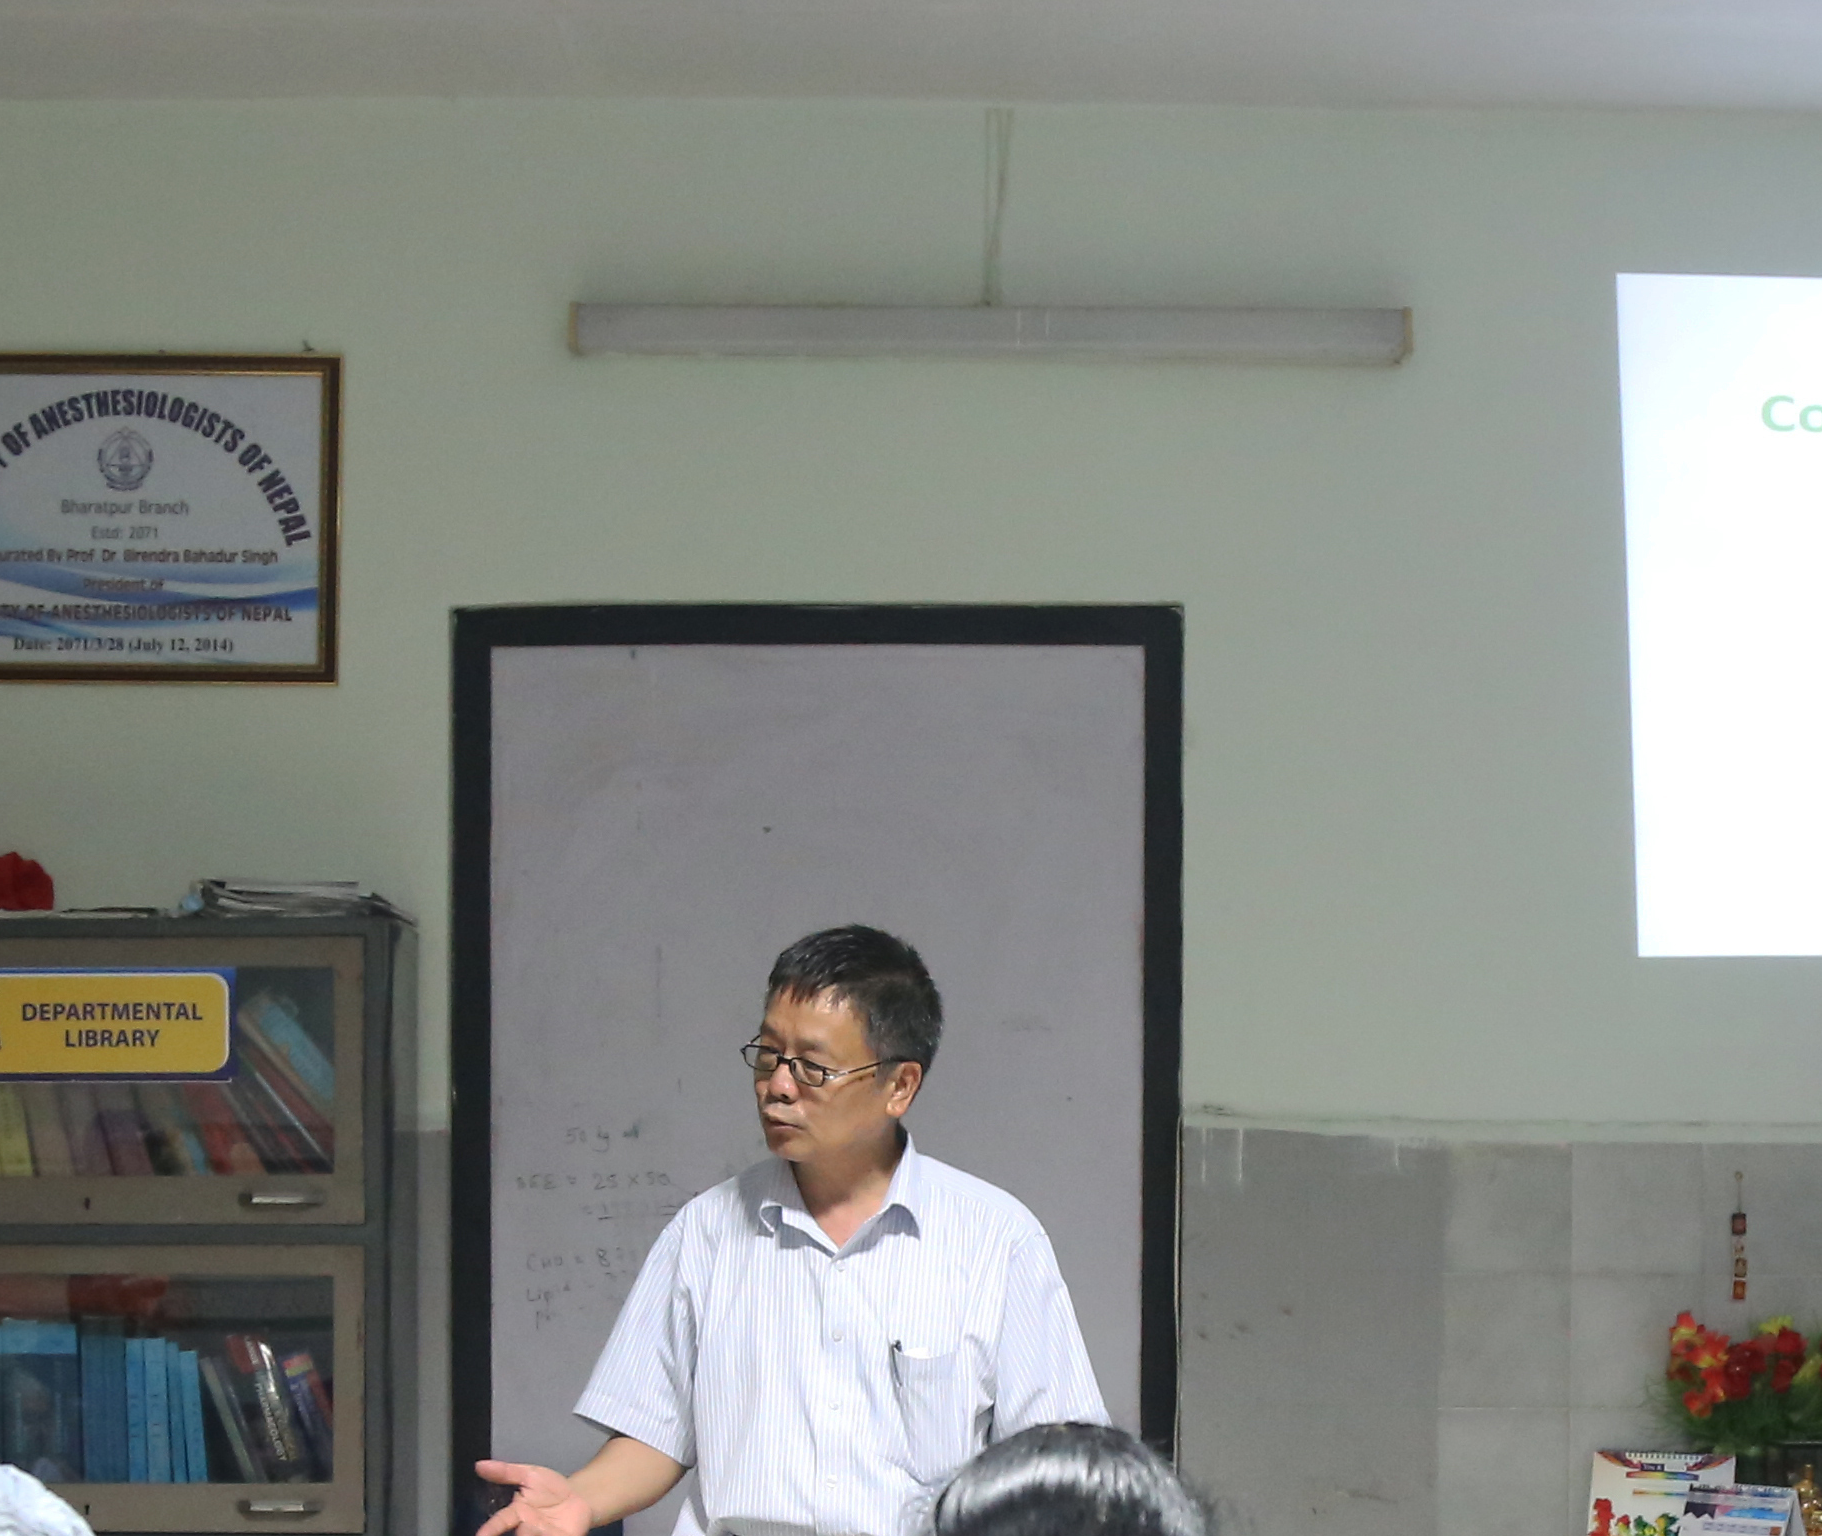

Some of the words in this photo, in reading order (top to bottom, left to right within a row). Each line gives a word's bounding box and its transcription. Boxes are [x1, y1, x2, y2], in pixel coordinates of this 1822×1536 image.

[1, 422, 30, 456] OF
[29, 389, 245, 452] ANESTHESIOLOGISTS
[238, 443, 272, 473] OF
[257, 469, 312, 547] NEPAL
[139, 500, 189, 514] Branch
[129, 526, 158, 540] 2071
[241, 606, 292, 622] NEPAL
[21, 1003, 203, 1022] DEPARTMENTAL
[65, 1029, 160, 1048] LIBRARY
